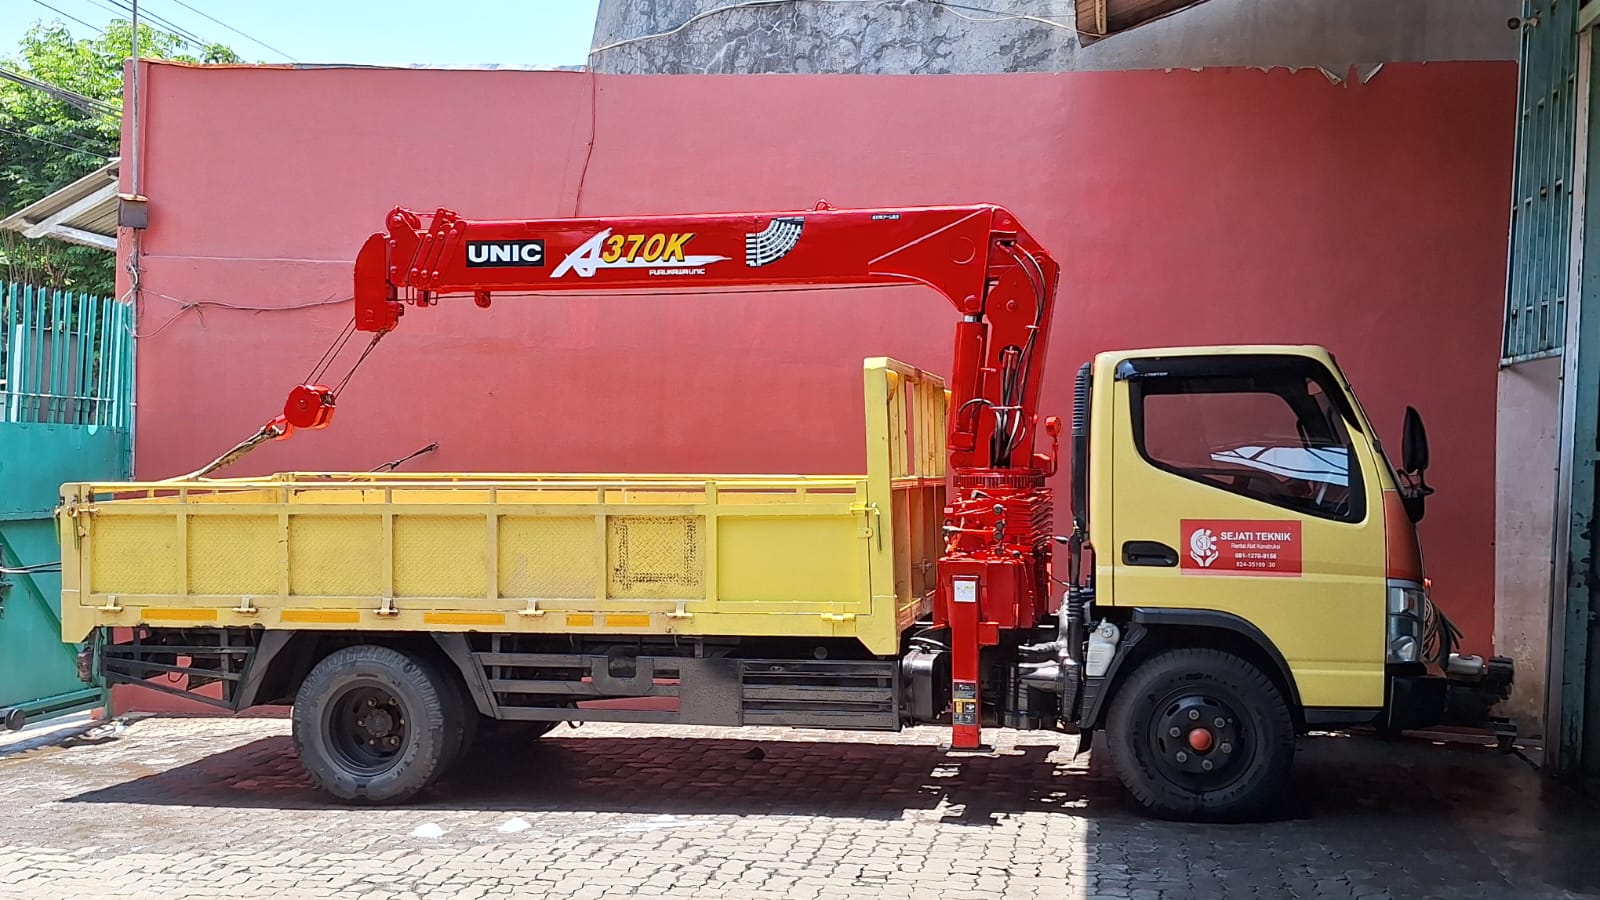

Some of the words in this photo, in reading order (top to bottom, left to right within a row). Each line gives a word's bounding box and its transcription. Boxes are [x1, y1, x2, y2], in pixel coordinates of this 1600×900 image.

[468, 244, 542, 263] UNIC
[1220, 532, 1253, 541] SEJATI
[1256, 532, 1291, 541] TEKNIK
